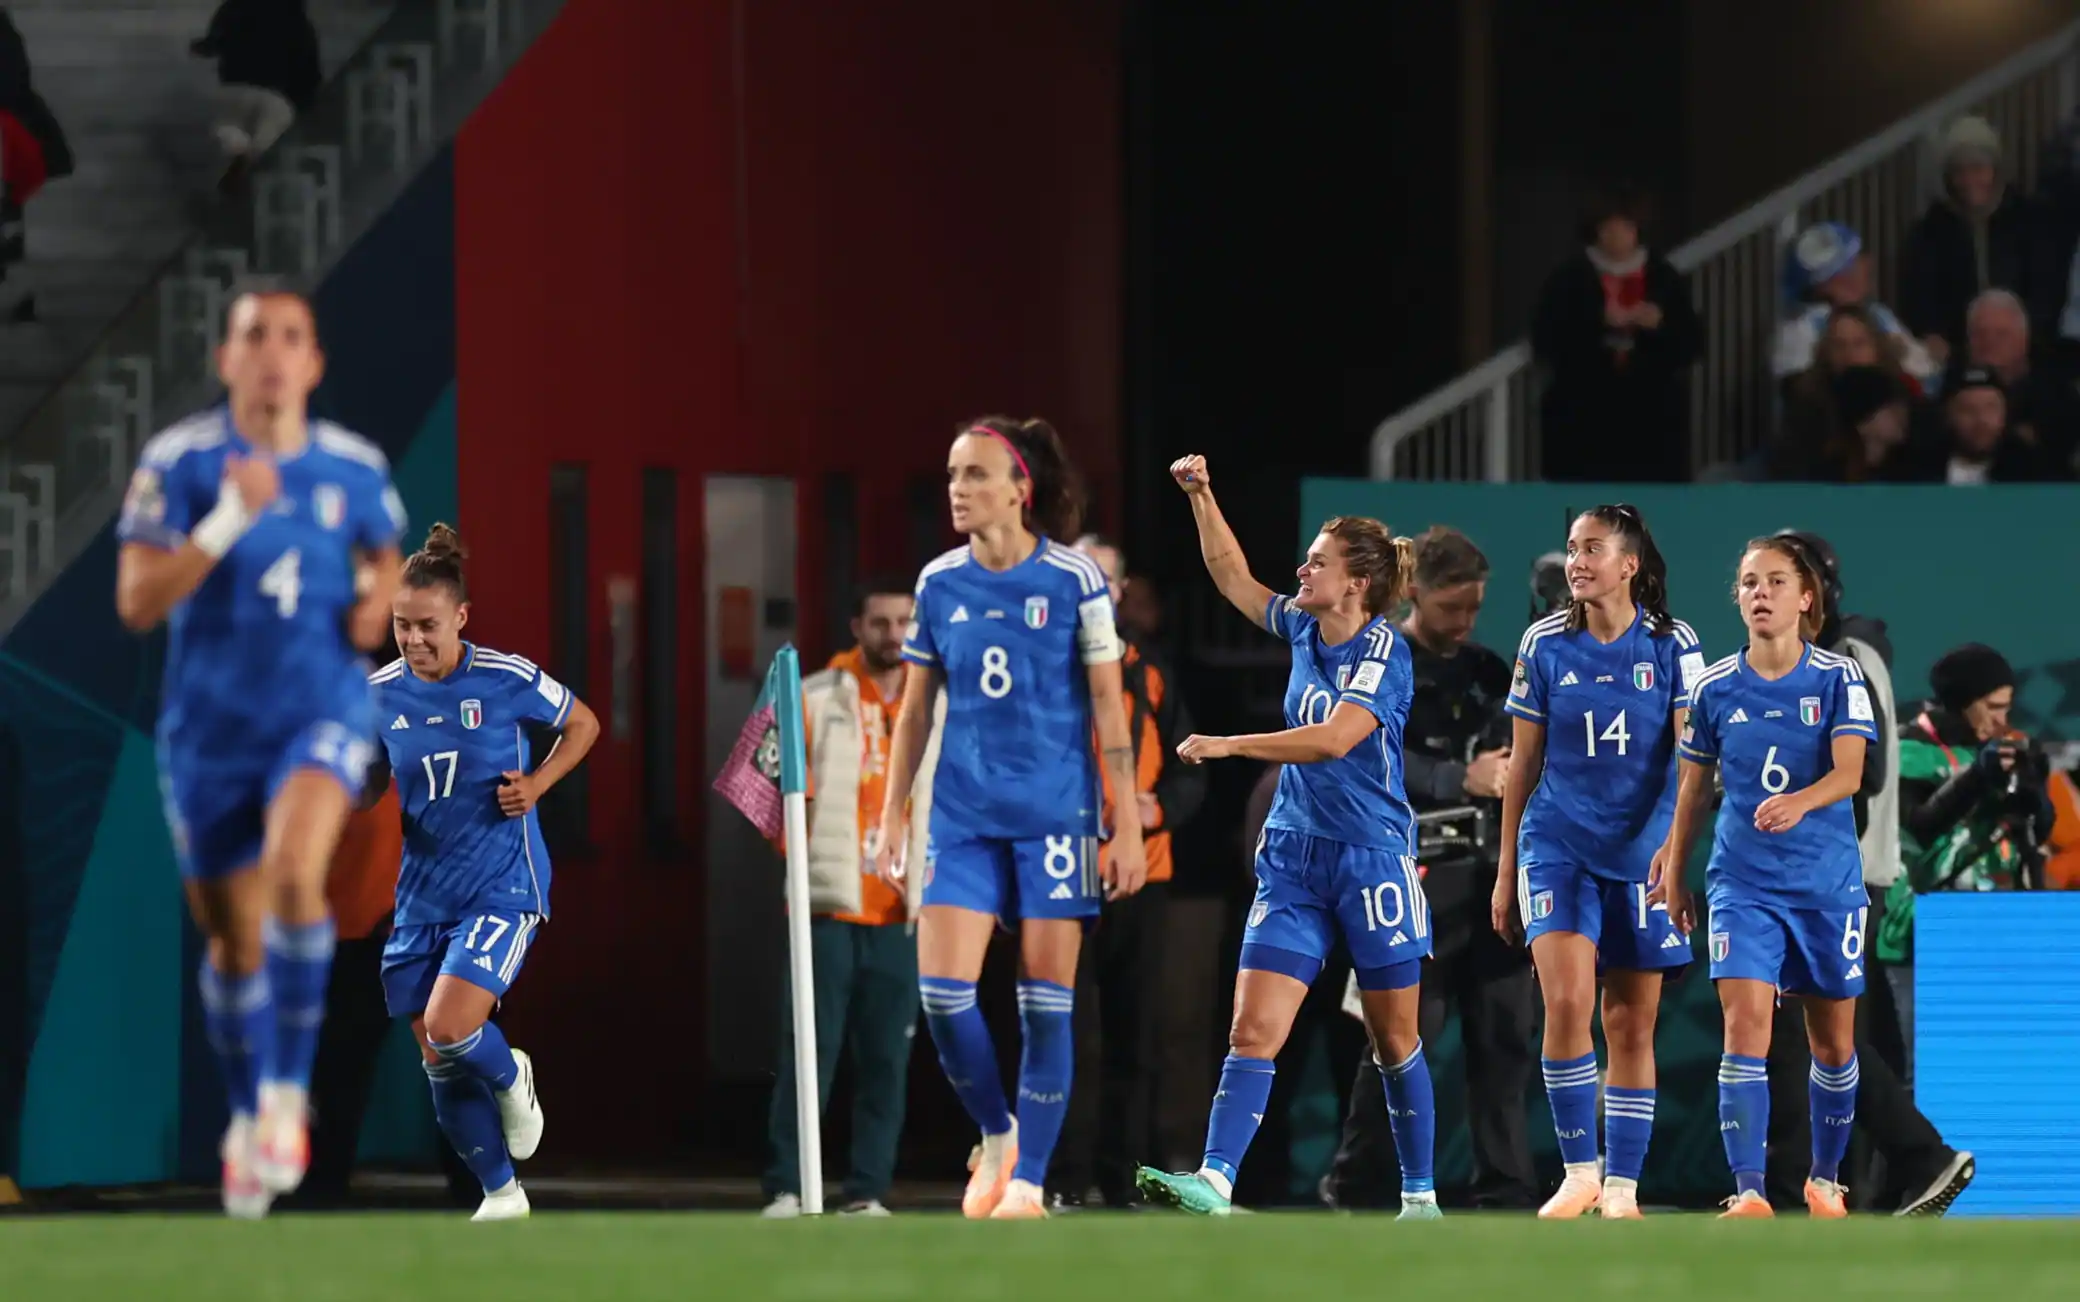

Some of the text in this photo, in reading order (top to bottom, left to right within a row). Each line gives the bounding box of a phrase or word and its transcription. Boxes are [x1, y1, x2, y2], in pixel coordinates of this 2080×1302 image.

[259, 550, 303, 618] 4
[980, 646, 1012, 699] 8
[1298, 683, 1332, 726] 10
[1583, 708, 1632, 757] 14
[421, 750, 459, 801] 17
[1761, 746, 1790, 793] 6
[1044, 834, 1076, 880] 8
[1361, 881, 1404, 931] 10
[465, 915, 511, 952] 17
[1841, 912, 1861, 960] 6
